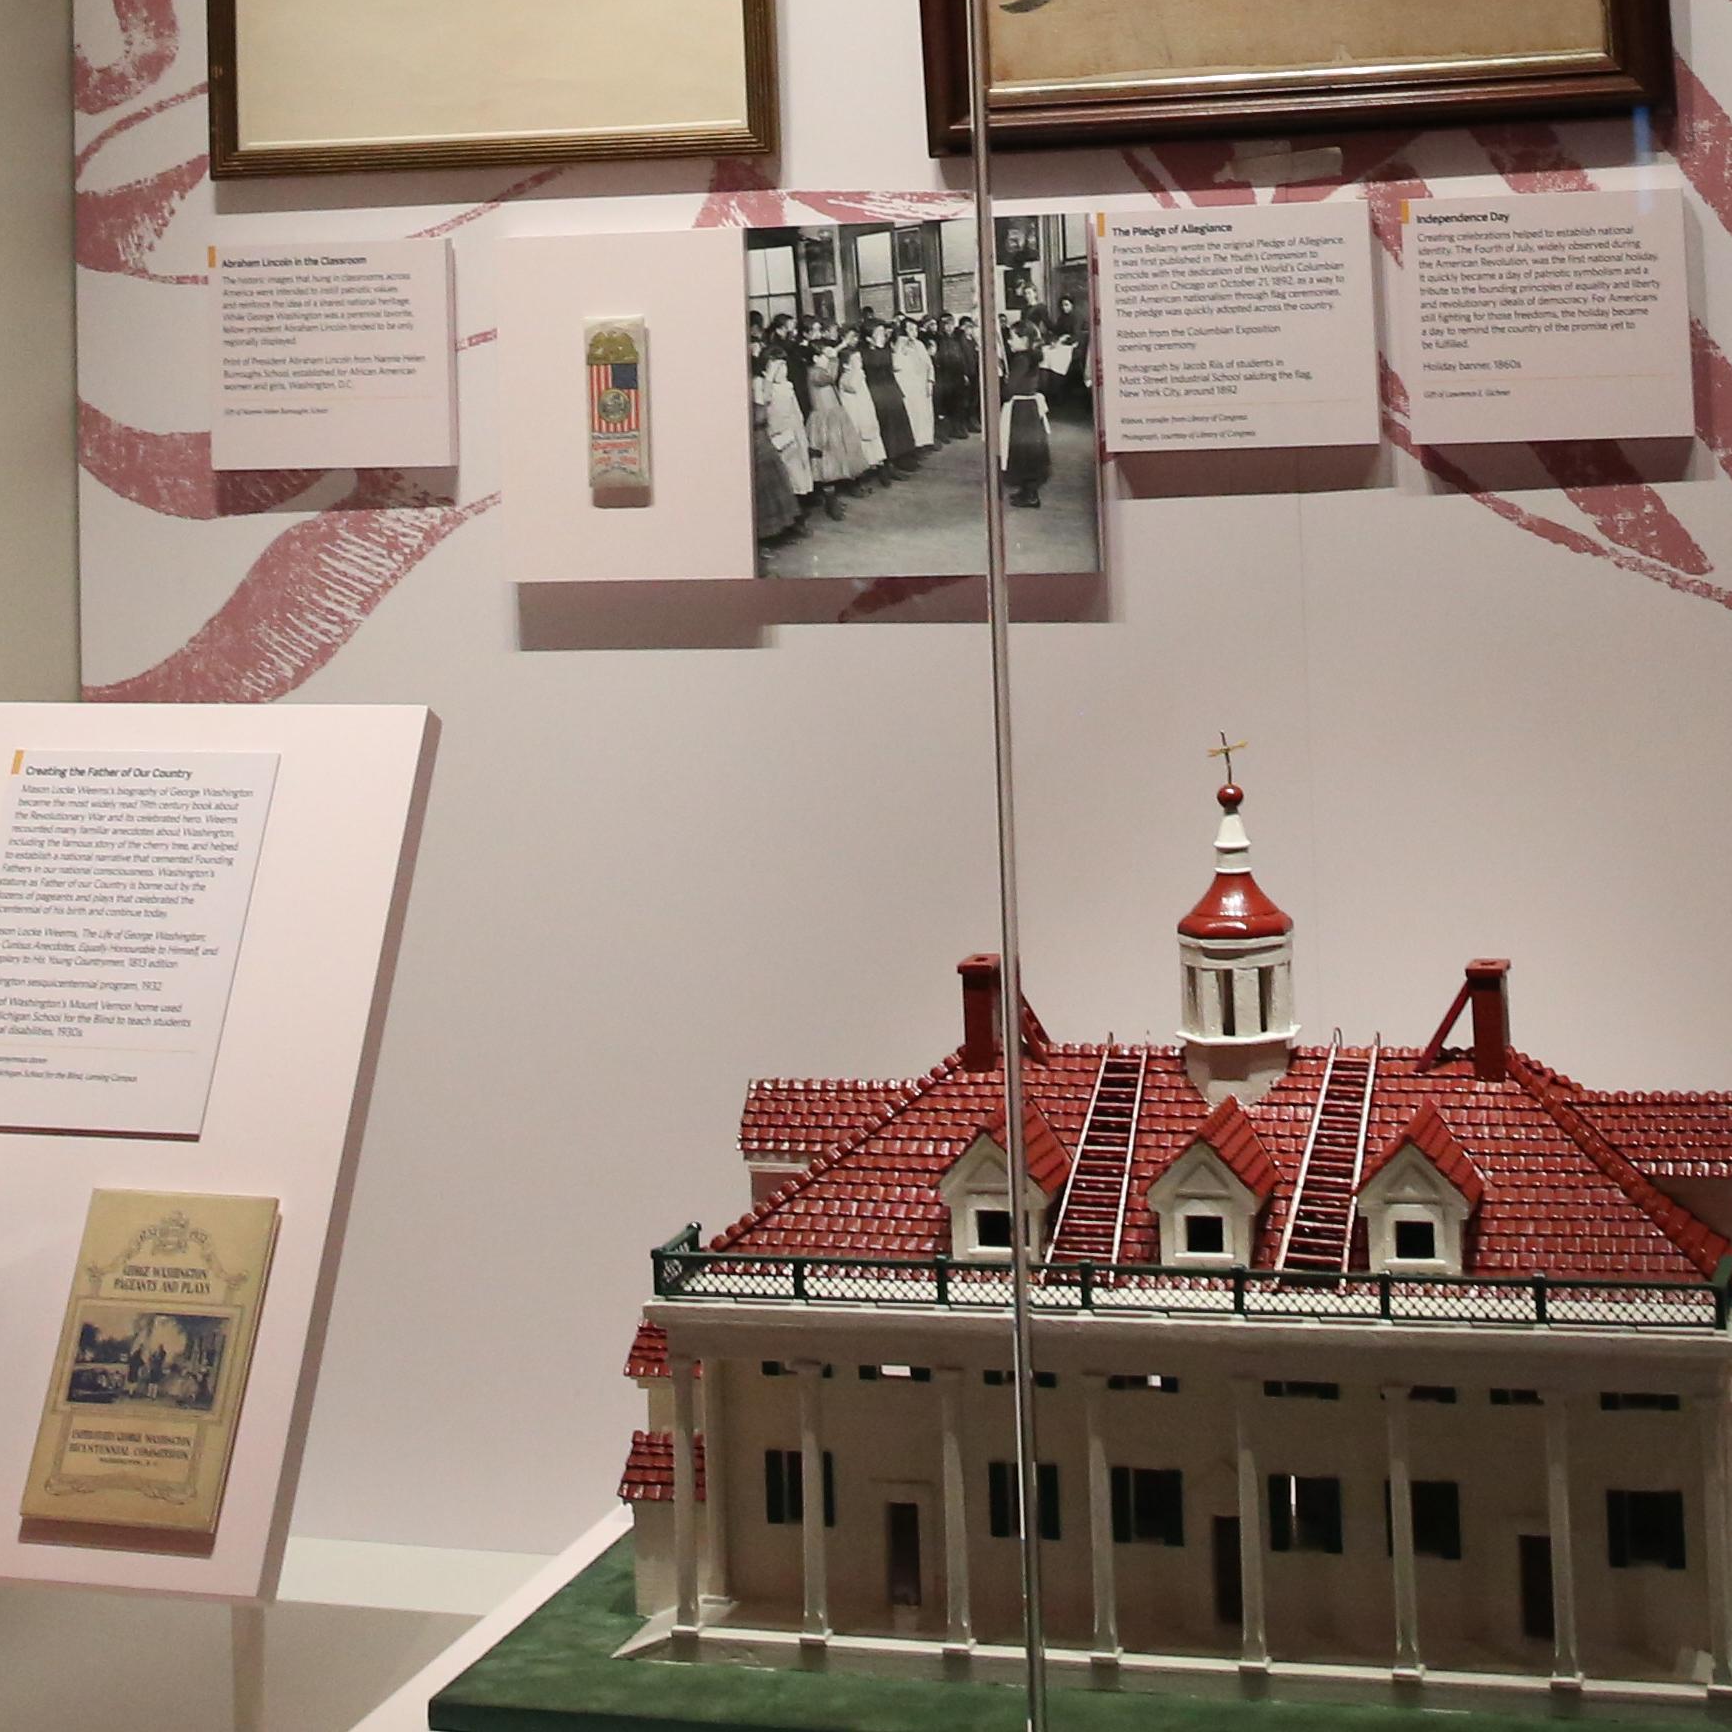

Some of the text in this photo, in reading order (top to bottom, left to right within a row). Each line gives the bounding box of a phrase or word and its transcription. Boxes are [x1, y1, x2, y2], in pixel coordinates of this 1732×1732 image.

[1416, 210, 1510, 226] Independence Day
[1111, 223, 1233, 237] The Pledge of Allegiance
[24, 766, 193, 780] Creating the Father of Our Country
